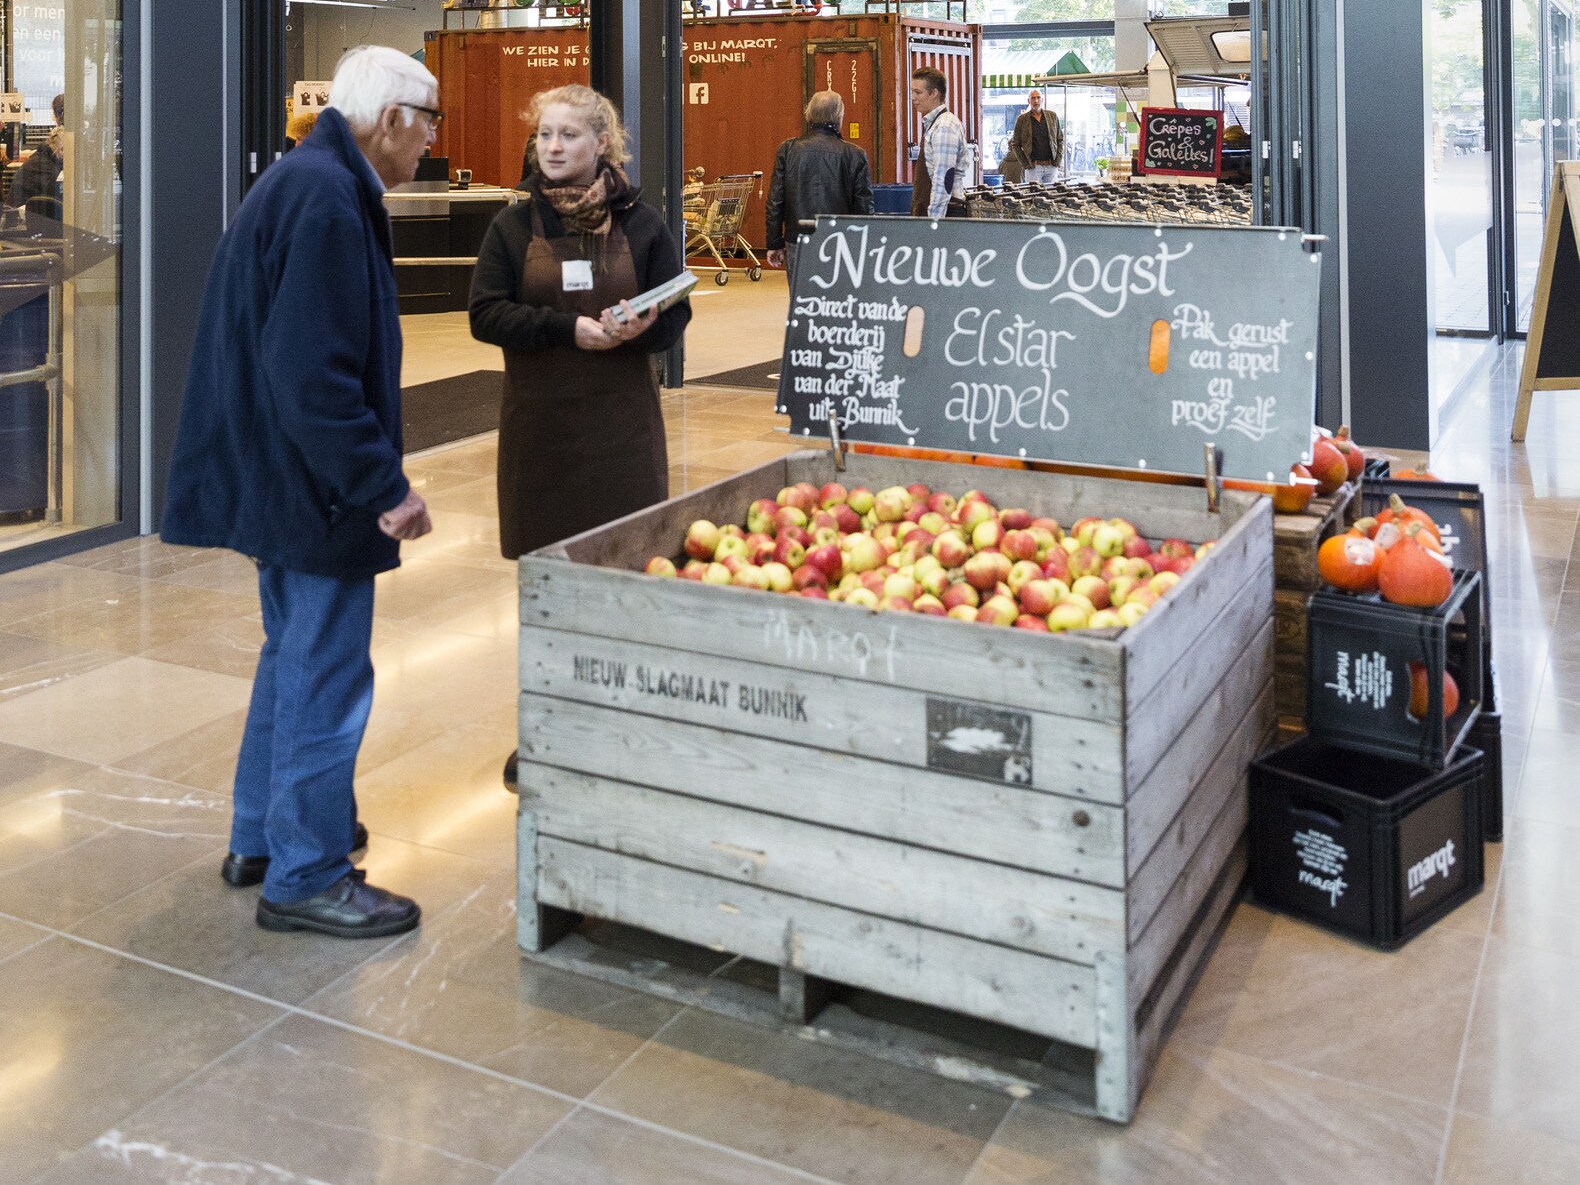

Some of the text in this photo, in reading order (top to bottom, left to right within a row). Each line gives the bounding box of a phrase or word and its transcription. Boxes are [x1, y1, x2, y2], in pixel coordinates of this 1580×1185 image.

[502, 46, 524, 56] WE
[527, 45, 560, 55] ZIEN
[564, 45, 582, 55] JE
[527, 58, 560, 68] HIER
[563, 58, 577, 67] IN
[689, 52, 746, 64] ONLINE!
[693, 41, 717, 52] BIJ
[1177, 136, 1195, 149] &
[809, 225, 1194, 318] Nieuwe Oogst
[794, 294, 858, 318] Direct
[807, 318, 886, 353] boerderij
[944, 307, 1077, 369] Elstar
[1170, 303, 1293, 350] Pak gerust
[790, 349, 823, 368] van
[1189, 344, 1280, 381] een appel
[794, 376, 823, 394] van
[824, 373, 854, 396] der
[1207, 377, 1234, 399] en
[809, 396, 920, 434] uit Bunnik
[945, 368, 1071, 443] appels
[1171, 395, 1281, 442] proef zelf
[573, 653, 808, 723] NIEUW SLAGMAAT BUNNIK
[1407, 838, 1457, 892] marqt
